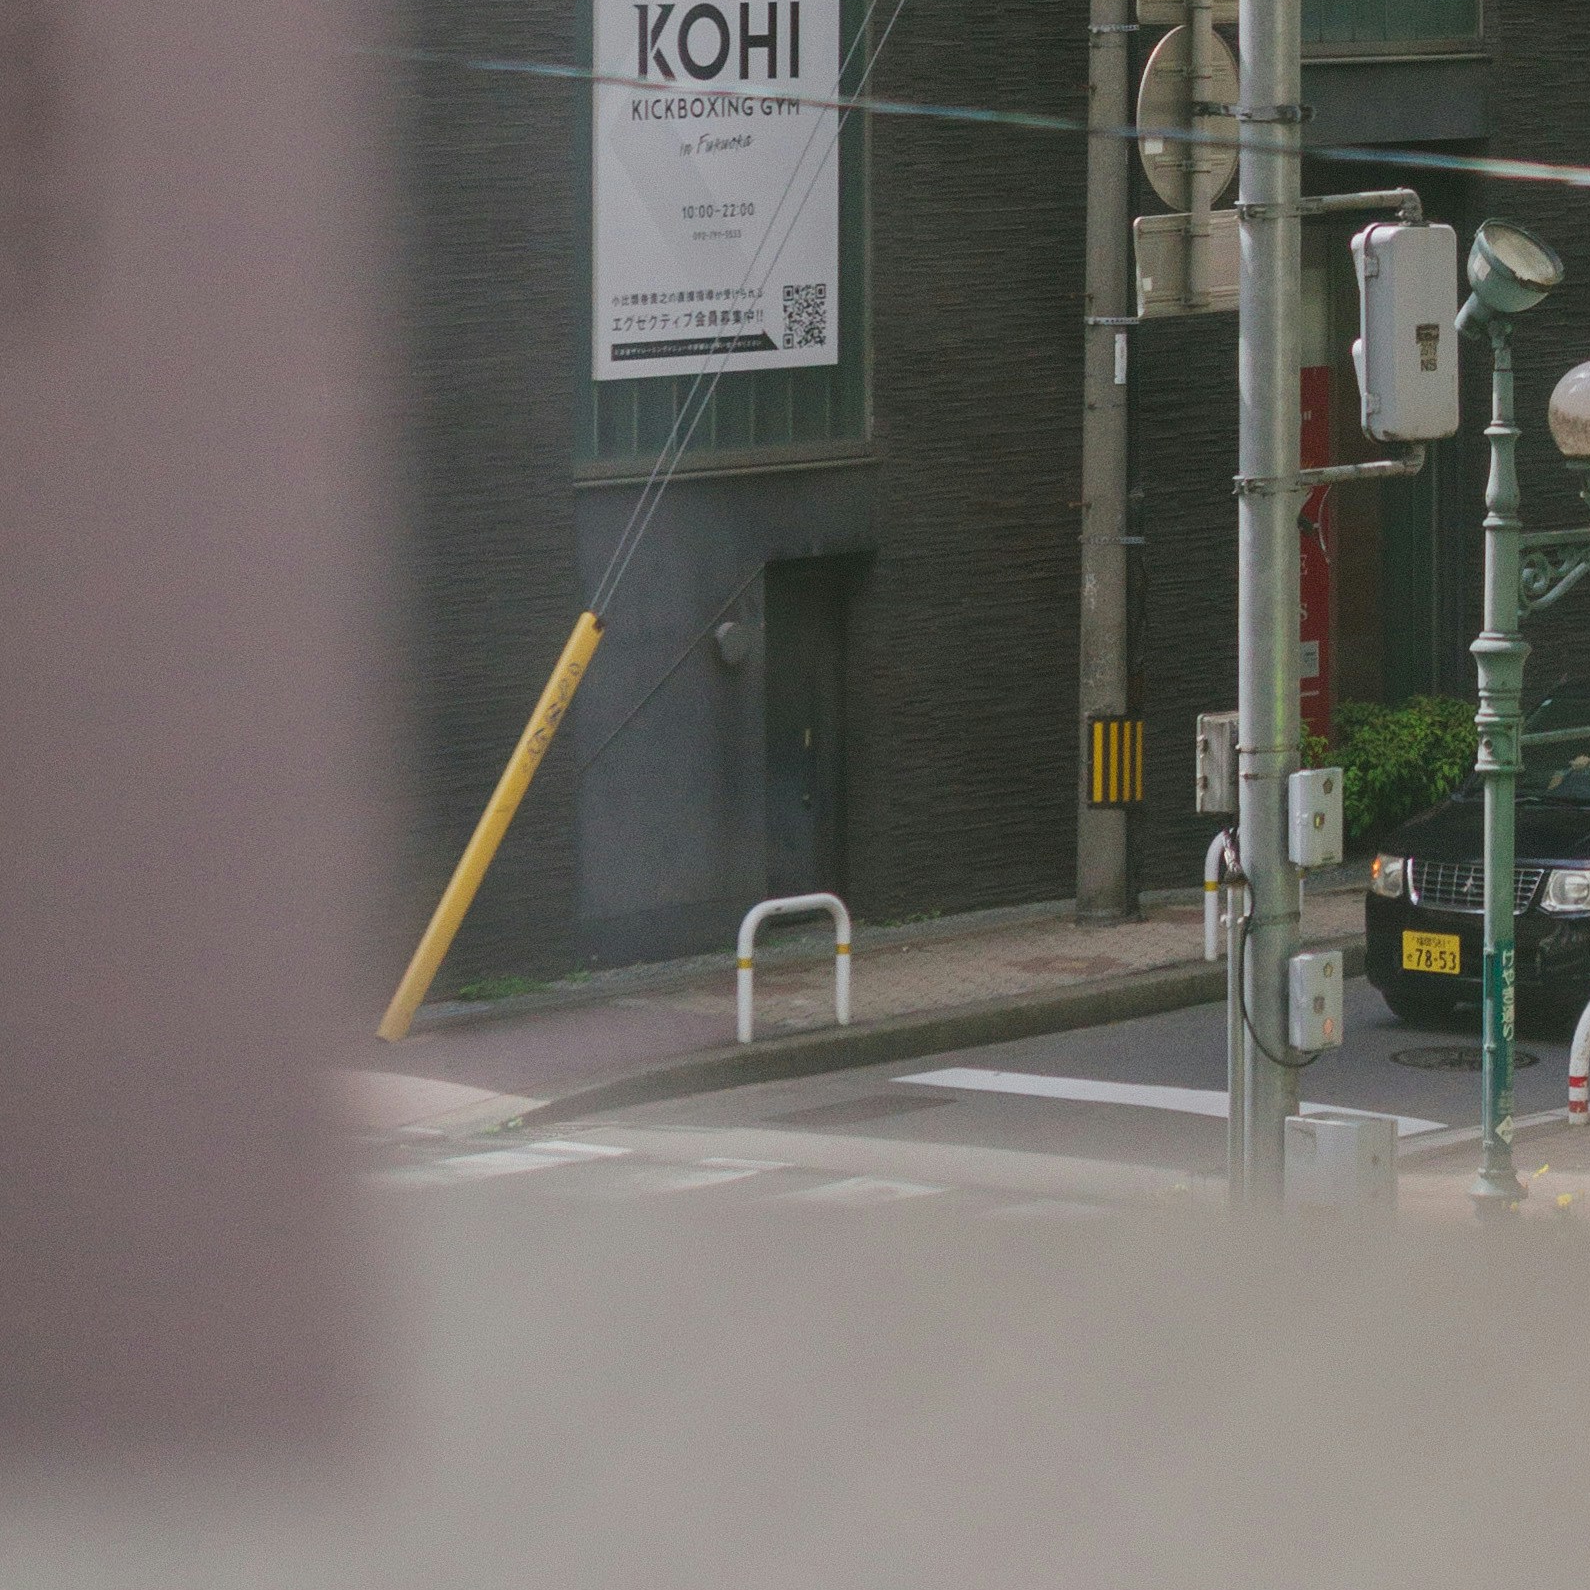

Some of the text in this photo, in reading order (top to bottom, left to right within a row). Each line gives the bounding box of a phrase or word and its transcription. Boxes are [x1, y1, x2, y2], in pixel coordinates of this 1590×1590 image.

[634, 2, 800, 81] KOHI
[632, 96, 800, 121] KICKBOXING GYM
[695, 133, 754, 155] Fukuoka
